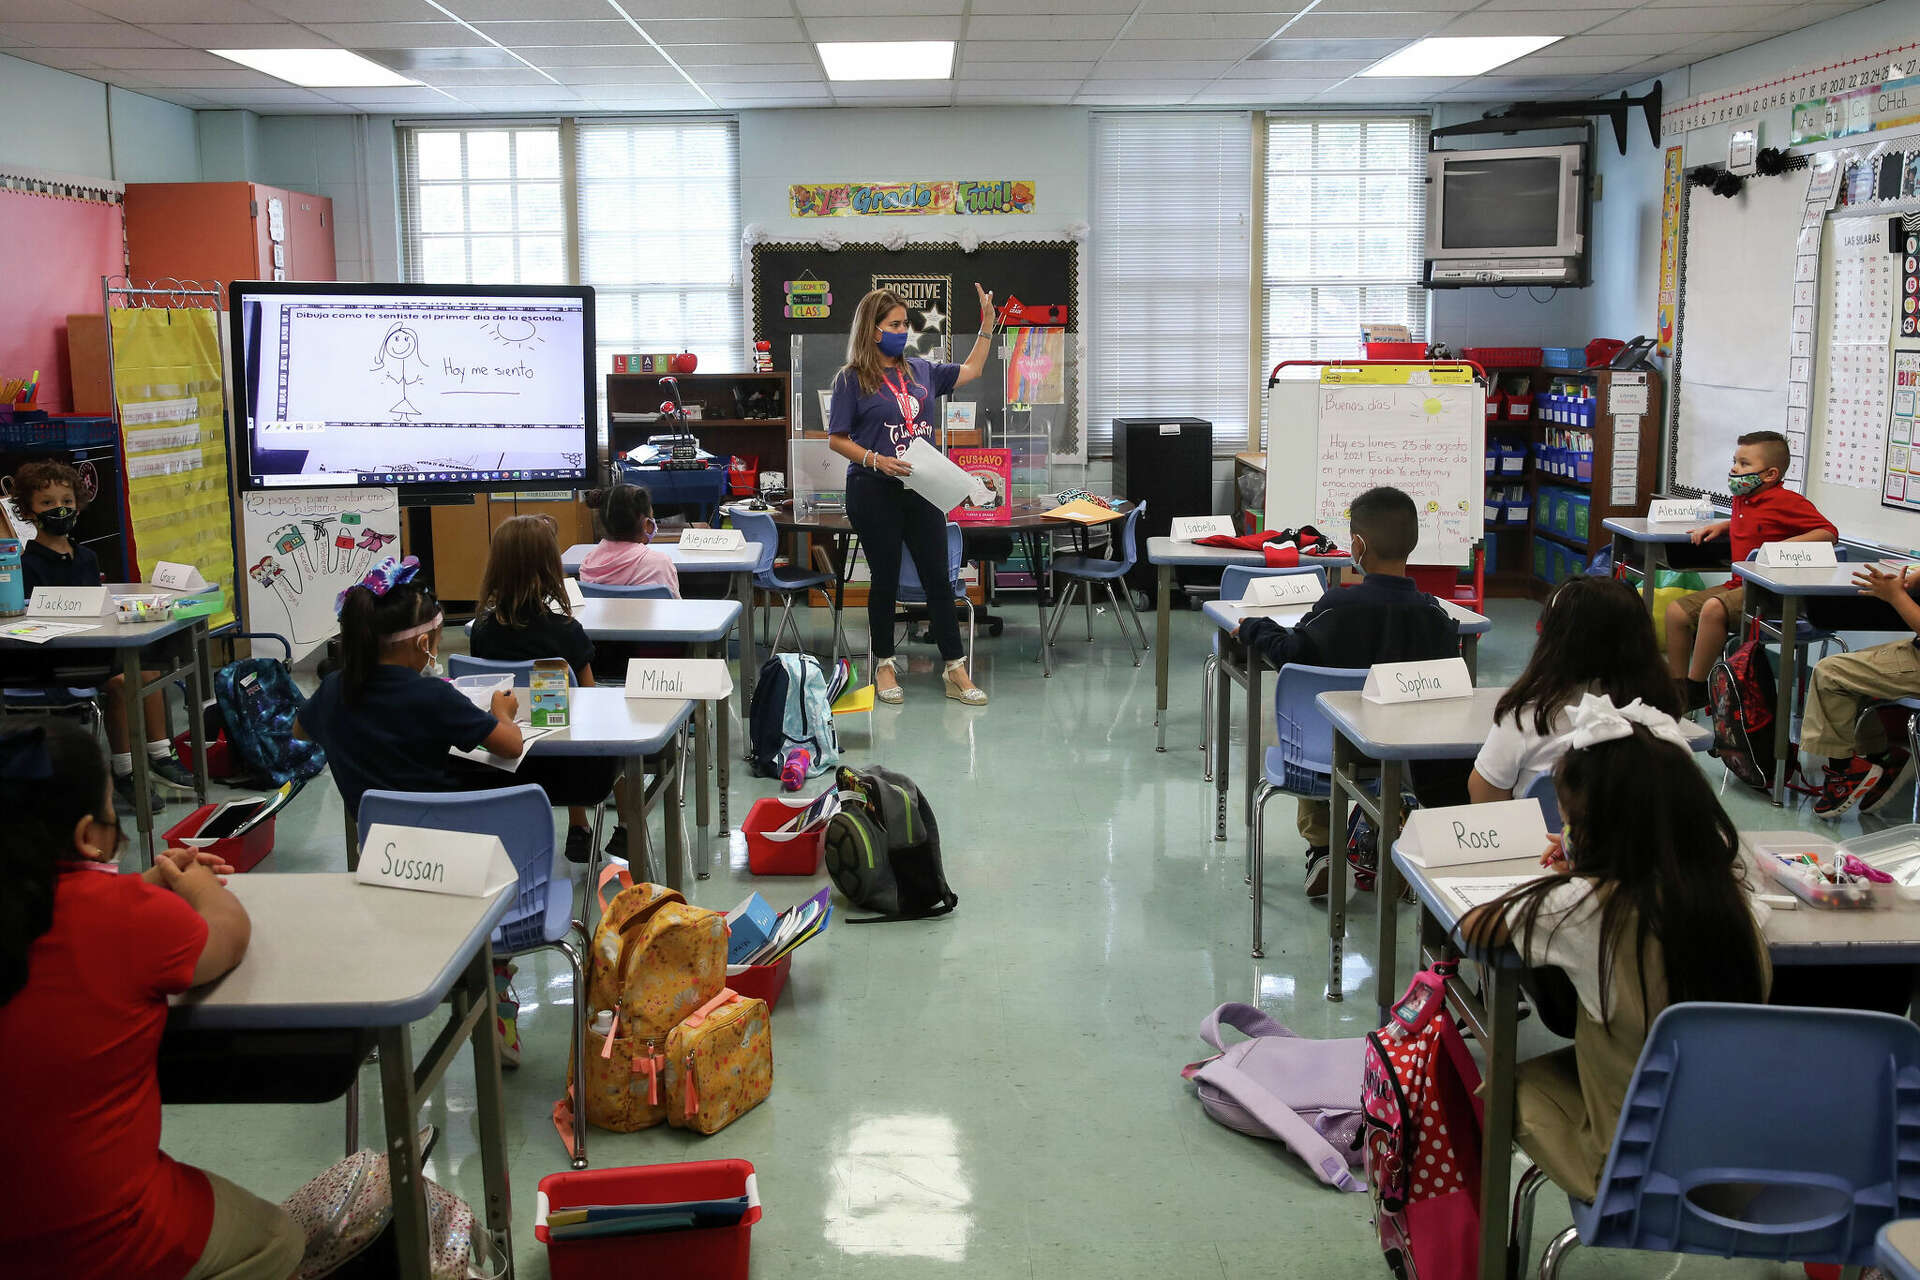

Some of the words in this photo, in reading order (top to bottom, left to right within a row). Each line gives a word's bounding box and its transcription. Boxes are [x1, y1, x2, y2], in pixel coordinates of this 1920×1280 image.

[1701, 116, 1706, 126] 6
[1711, 112, 1716, 123] 7
[1720, 110, 1724, 121] 8
[1728, 108, 1733, 118] 9
[1736, 105, 1743, 117] 10
[1753, 100, 1759, 112] 12
[1762, 98, 1768, 110] 13
[1771, 96, 1777, 107] 14
[1780, 93, 1786, 105] 15
[1790, 90, 1796, 102] 16
[1800, 88, 1806, 100] 17
[1809, 85, 1815, 98] 18
[1820, 82, 1827, 95] 19
[1829, 80, 1838, 93] 20
[1839, 78, 1846, 90] 21
[1848, 75, 1858, 88] 22
[1860, 72, 1869, 85] 23
[1870, 68, 1880, 83] 24
[1881, 66, 1890, 80] 25
[1905, 60, 1917, 75] 27
[851, 183, 932, 214] Grade
[954, 181, 1012, 215] Fun!
[1909, 260, 1914, 270] 8
[819, 283, 828, 292] TO
[884, 282, 941, 300] POSITIVE
[1907, 279, 1915, 290] 15
[296, 312, 329, 320] Dibuja
[794, 305, 822, 318] CLASS
[1905, 320, 1914, 331] 29
[443, 356, 466, 384] Hoy
[471, 366, 489, 376] me
[494, 359, 534, 379] siento
[1330, 434, 1347, 453] Hoy
[1351, 440, 1365, 448] es
[1368, 434, 1397, 449] lunes
[1402, 439, 1418, 451] 23
[1420, 438, 1431, 451] de
[1436, 436, 1468, 454] agosto
[959, 455, 1003, 466] GUSTAVO
[1322, 449, 1338, 461] del
[1368, 451, 1382, 462] Es
[1385, 453, 1416, 463] nuestro
[1419, 455, 1448, 467] primer
[1322, 466, 1333, 475] en
[1338, 466, 1364, 479] primer
[1369, 466, 1395, 477] grado
[1410, 465, 1431, 479] estoy
[1434, 469, 1451, 479] muy
[251, 491, 265, 507] 5
[294, 502, 338, 514] historia
[1184, 521, 1217, 534] Isabella
[684, 533, 729, 548] Alejandro
[1779, 549, 1812, 567] Angela
[159, 568, 177, 585] Grace
[1270, 582, 1310, 598] Dilan
[37, 594, 82, 612] Jackson
[641, 670, 685, 694] Mihali
[1395, 672, 1441, 697] Sophia
[1452, 820, 1500, 849] Rose
[381, 842, 445, 884] Sussan
